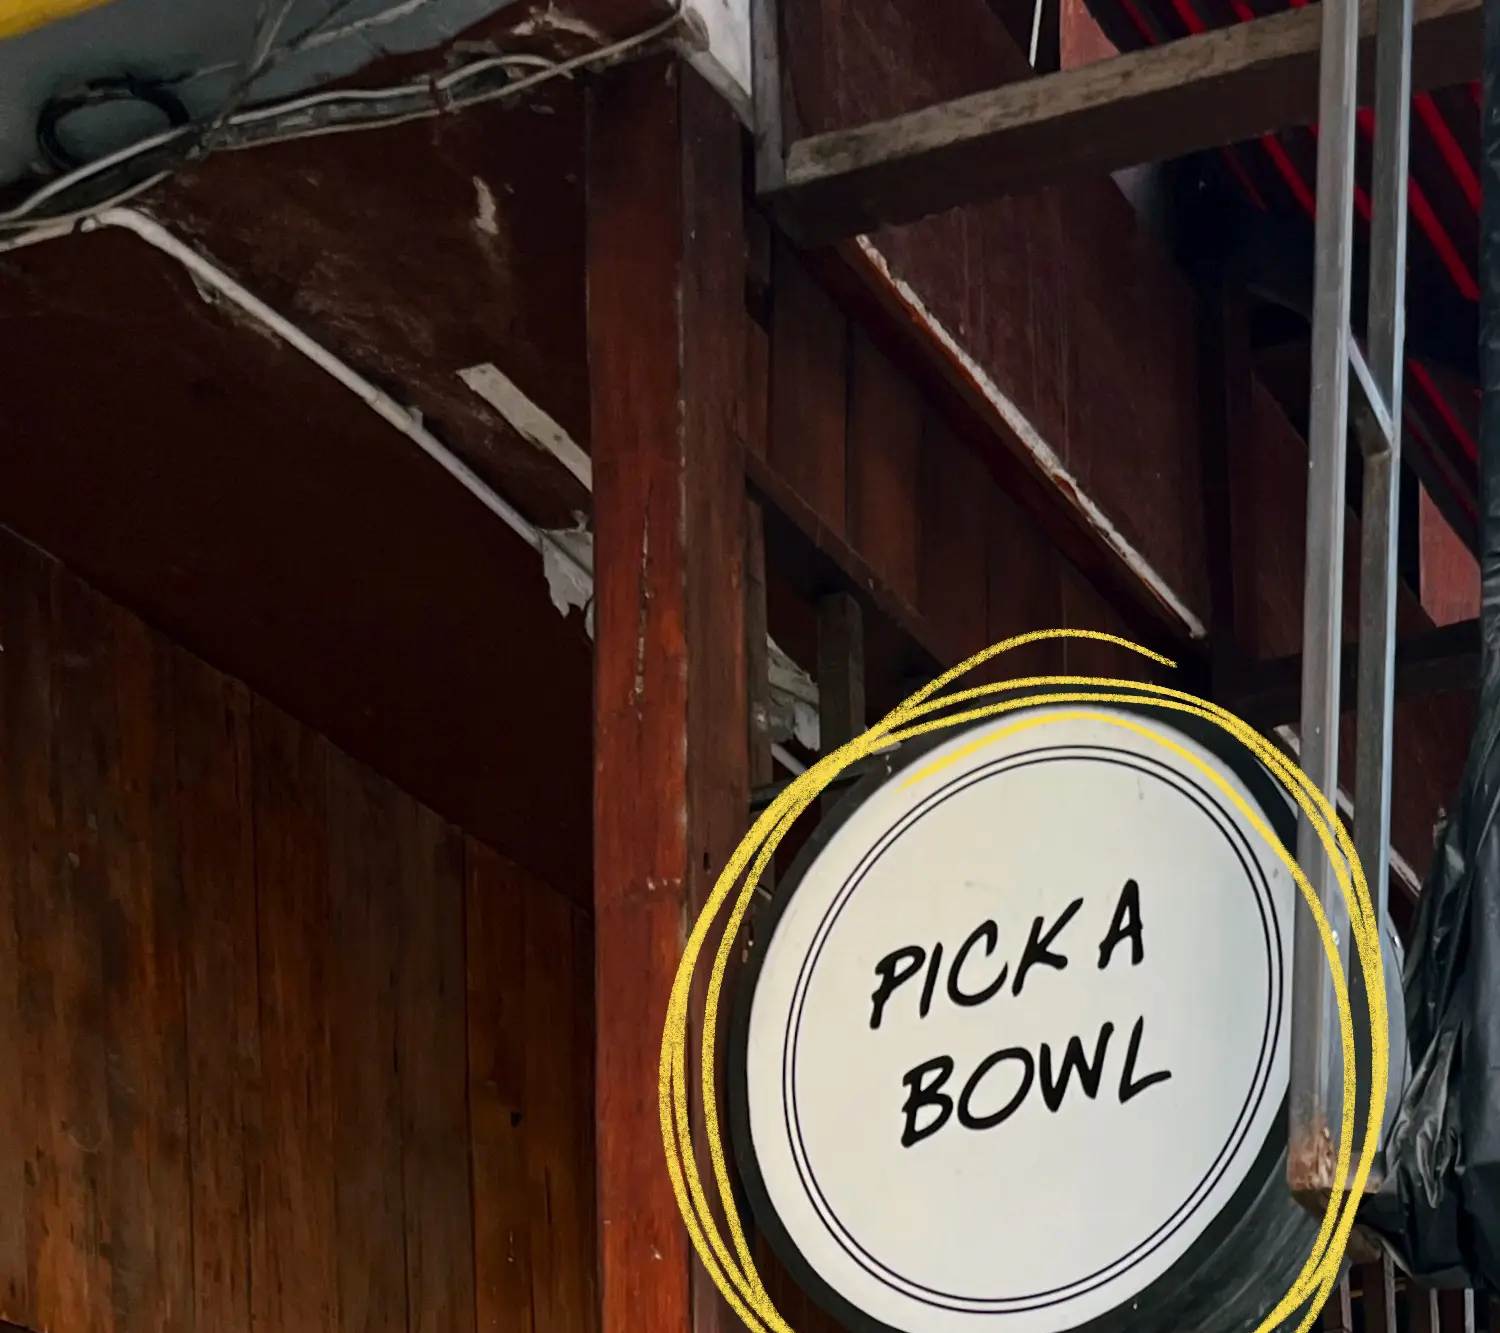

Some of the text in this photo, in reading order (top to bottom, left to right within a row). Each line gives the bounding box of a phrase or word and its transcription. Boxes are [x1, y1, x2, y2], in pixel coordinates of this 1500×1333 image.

[870, 879, 1143, 1030] PICK A
[900, 1017, 1171, 1147] BOWL
